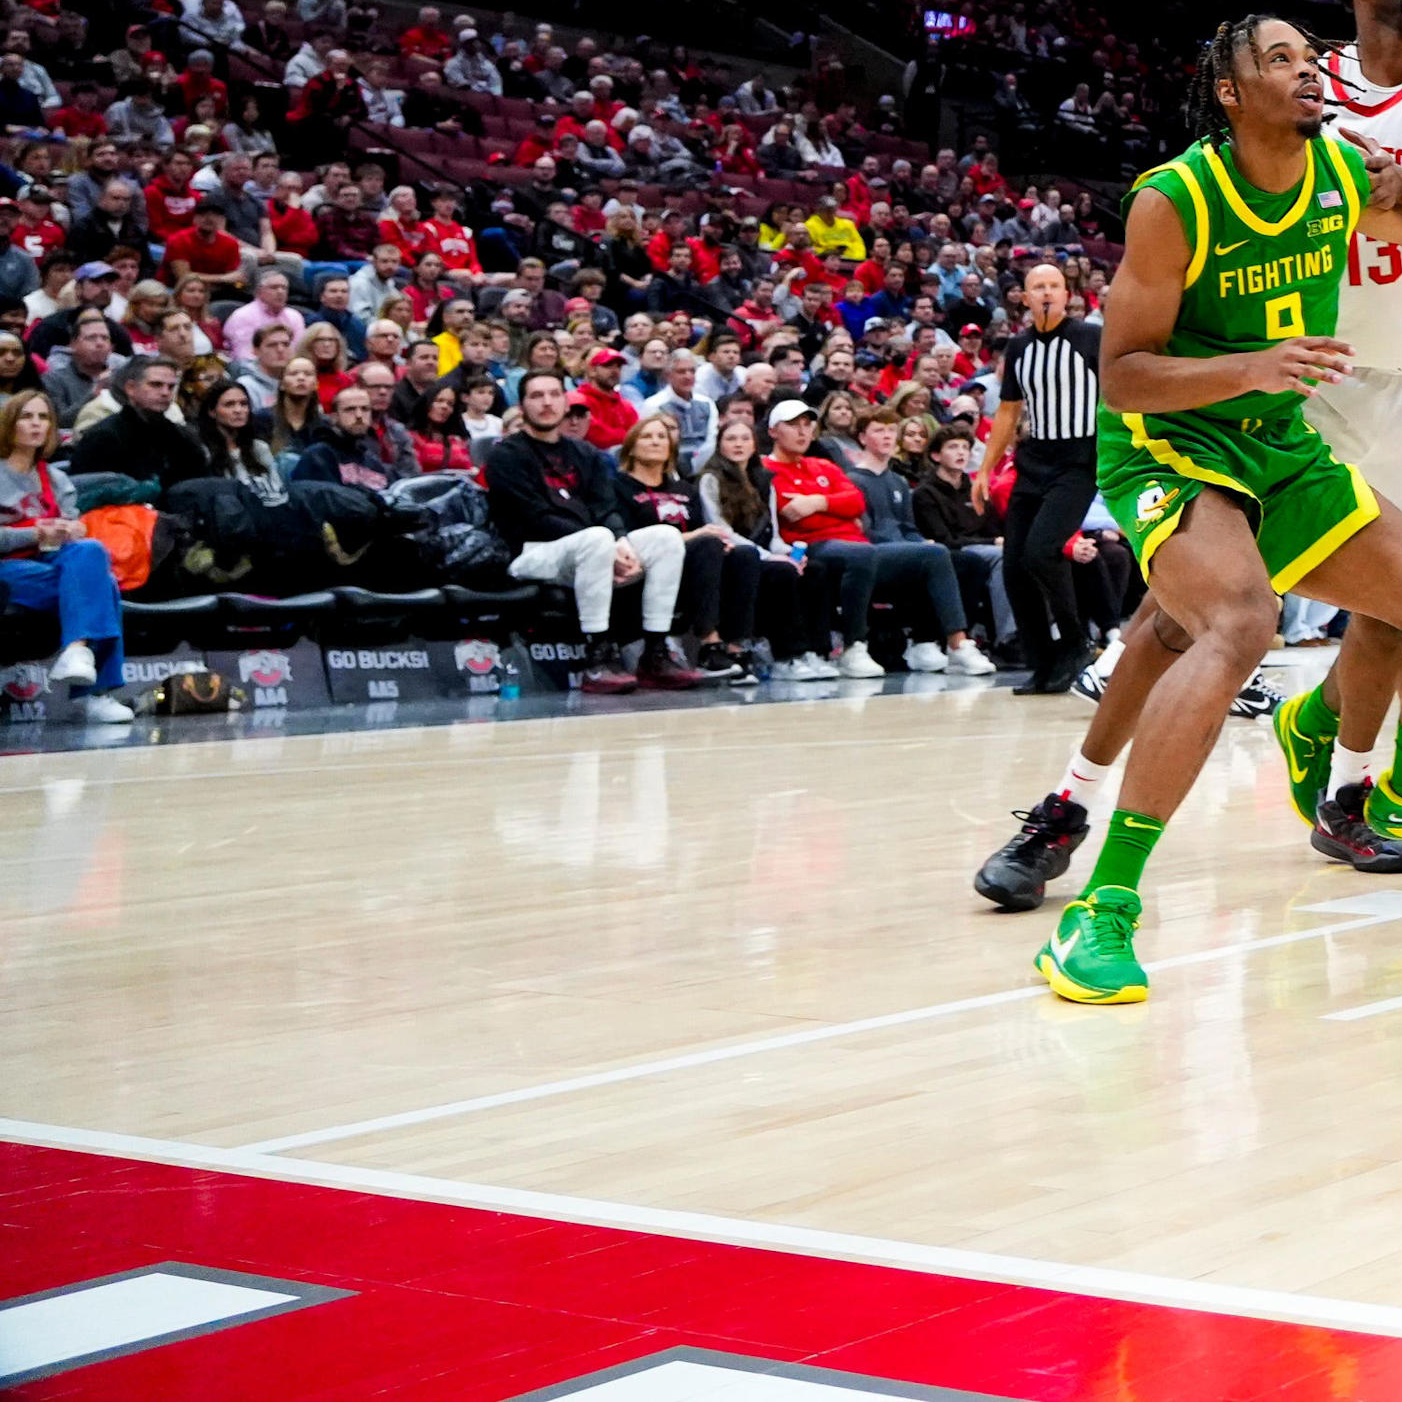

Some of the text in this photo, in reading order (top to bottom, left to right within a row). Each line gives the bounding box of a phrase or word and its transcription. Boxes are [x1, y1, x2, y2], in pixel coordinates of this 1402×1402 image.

[1219, 244, 1334, 298] FIGHTING
[328, 649, 430, 669] GO BUCKS!
[530, 643, 556, 661] GO
